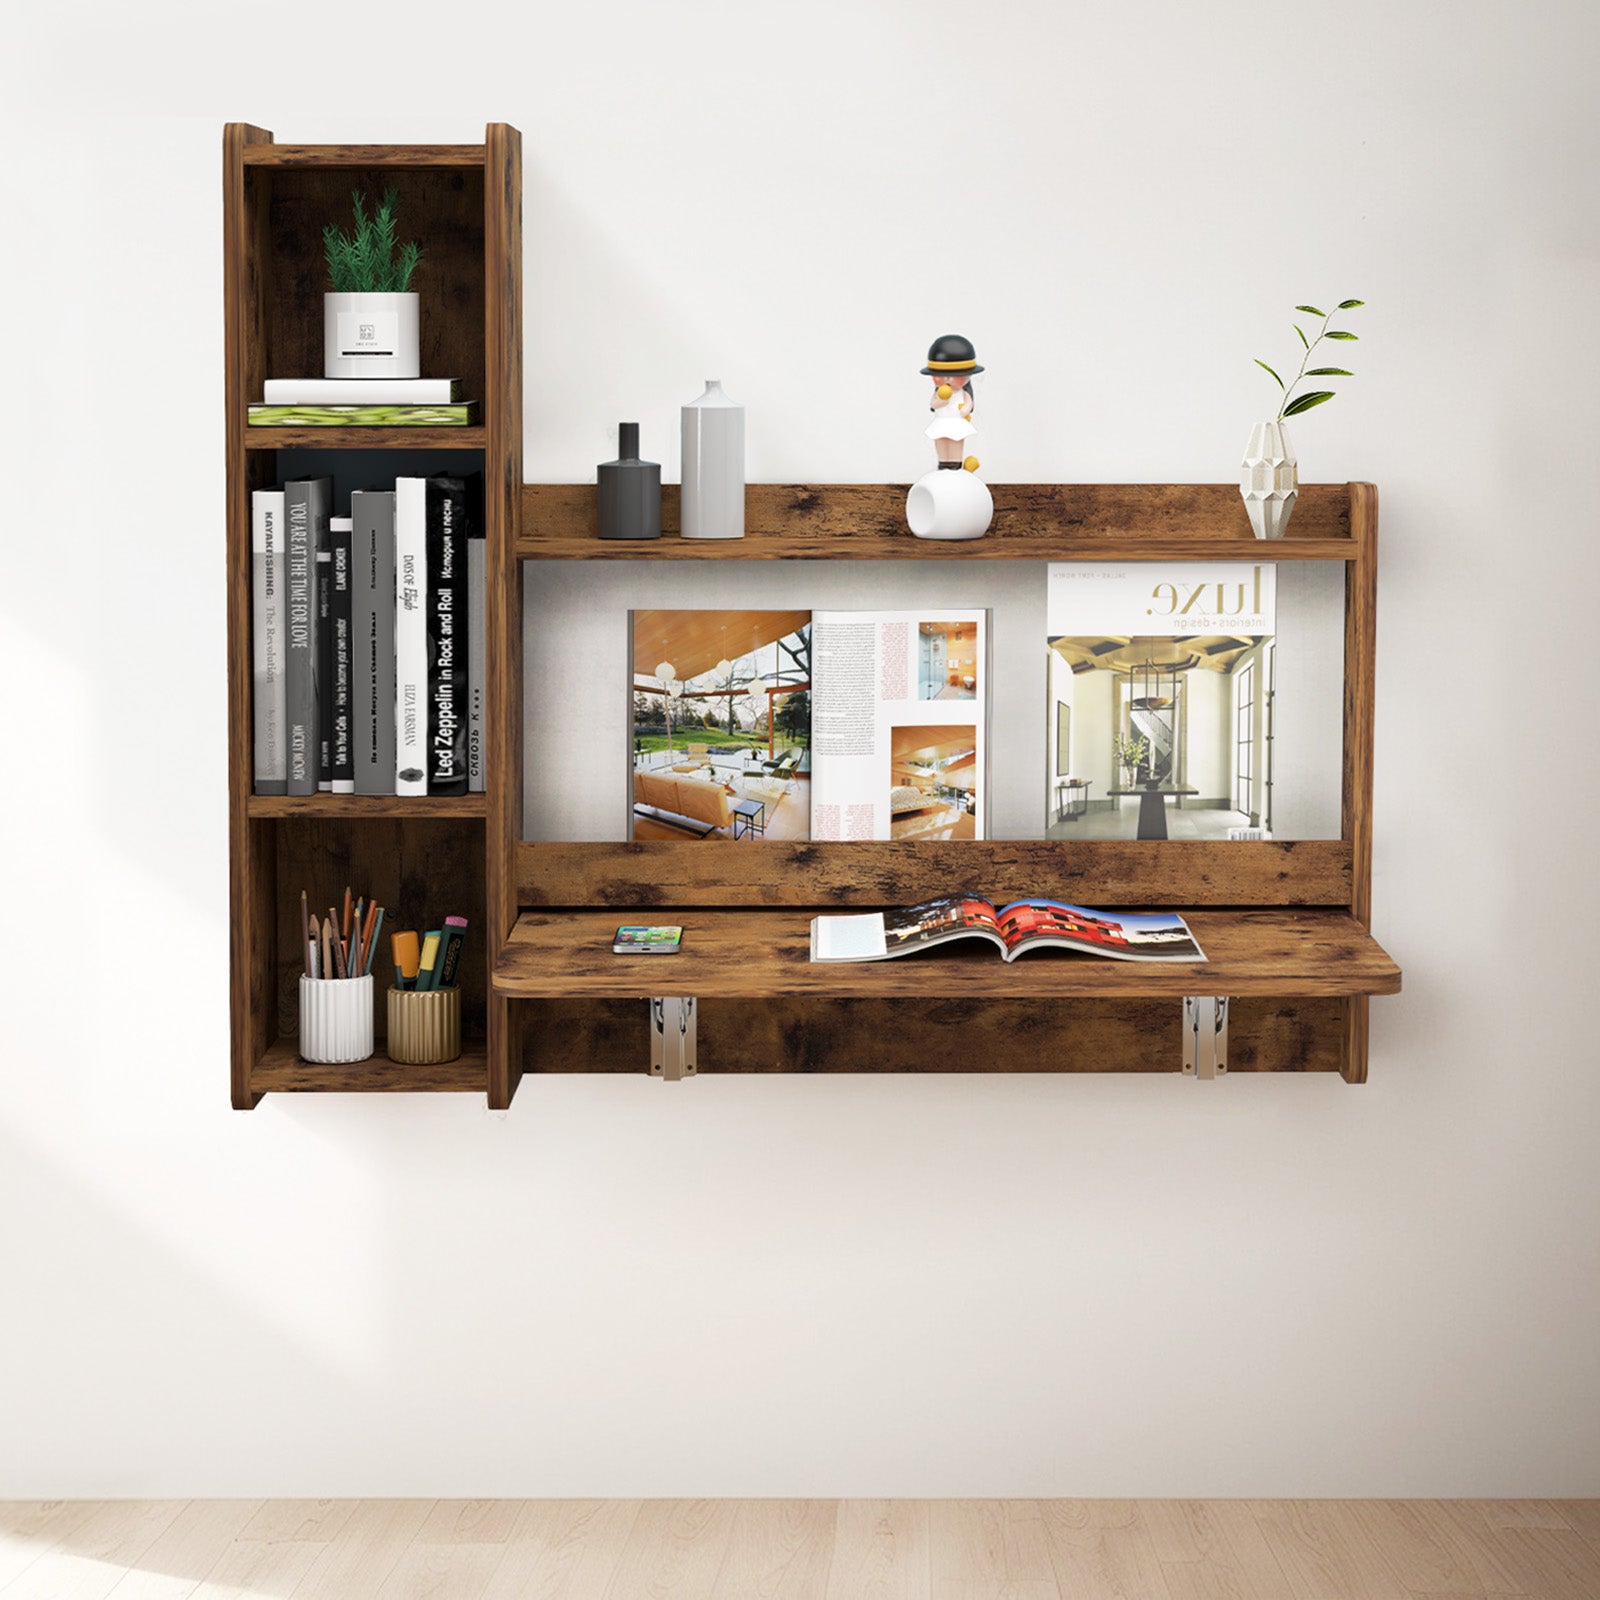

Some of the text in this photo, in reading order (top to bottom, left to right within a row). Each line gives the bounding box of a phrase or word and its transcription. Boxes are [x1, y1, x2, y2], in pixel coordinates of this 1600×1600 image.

[290, 502, 308, 648] YOU ARE AT THE TIME FOR LOVE
[403, 555, 415, 573] DAYS
[403, 574, 414, 585] OF
[264, 511, 276, 684] KAYAKFISHING: The Revolution
[404, 684, 416, 706] ELIZA
[435, 589, 458, 776] Led Zeppelin in Rock and Roll
[336, 731, 346, 745] Your
[470, 729, 479, 777] СКВОЗЬ
